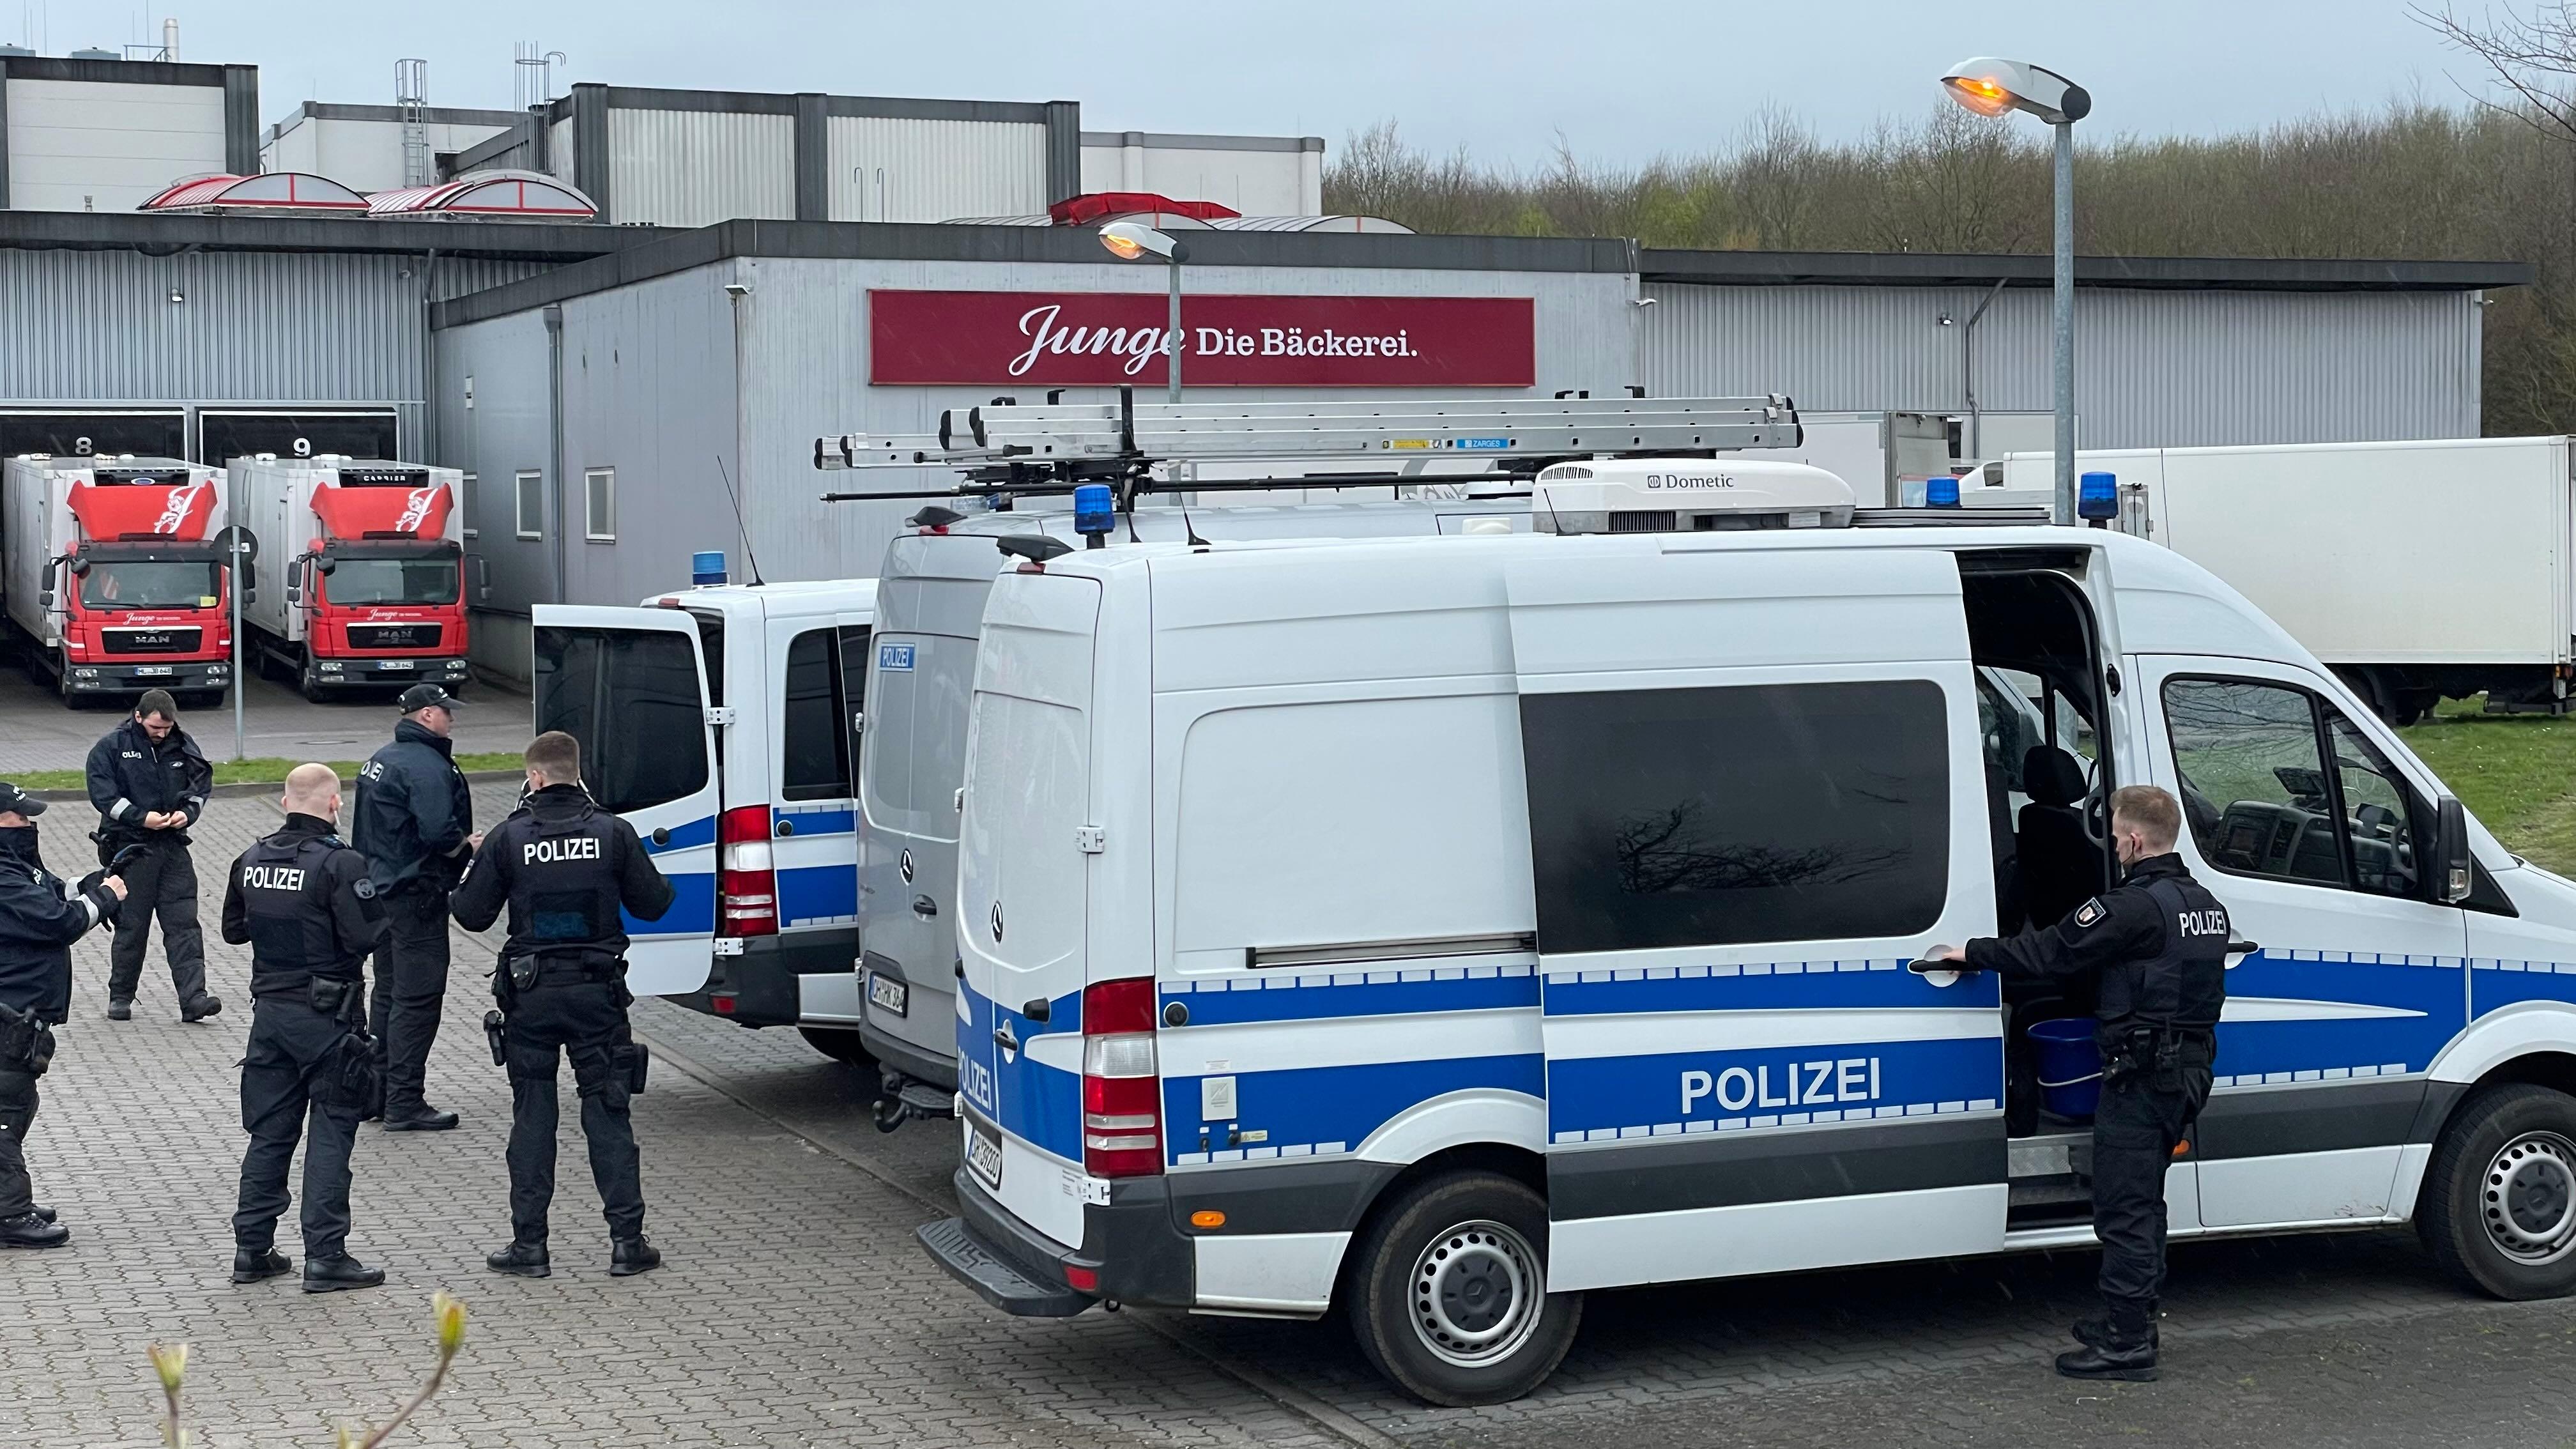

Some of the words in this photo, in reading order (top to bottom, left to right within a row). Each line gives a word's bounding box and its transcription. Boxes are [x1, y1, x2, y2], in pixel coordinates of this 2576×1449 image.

[1009, 305, 1186, 376] Junge
[1196, 328, 1255, 356] Die
[1261, 328, 1418, 356] Bäckerei.
[75, 438, 93, 455] 8
[293, 438, 310, 457] 9
[1666, 473, 1734, 488] Dometic
[123, 613, 155, 625] Junge
[367, 608, 398, 621] Junge
[882, 647, 910, 666] POLIZEI
[524, 838, 600, 865] POLIZEI
[243, 866, 305, 891] POLIZEI
[2179, 910, 2227, 937] POLIZEI
[1682, 1057, 1880, 1114] POLIZEI
